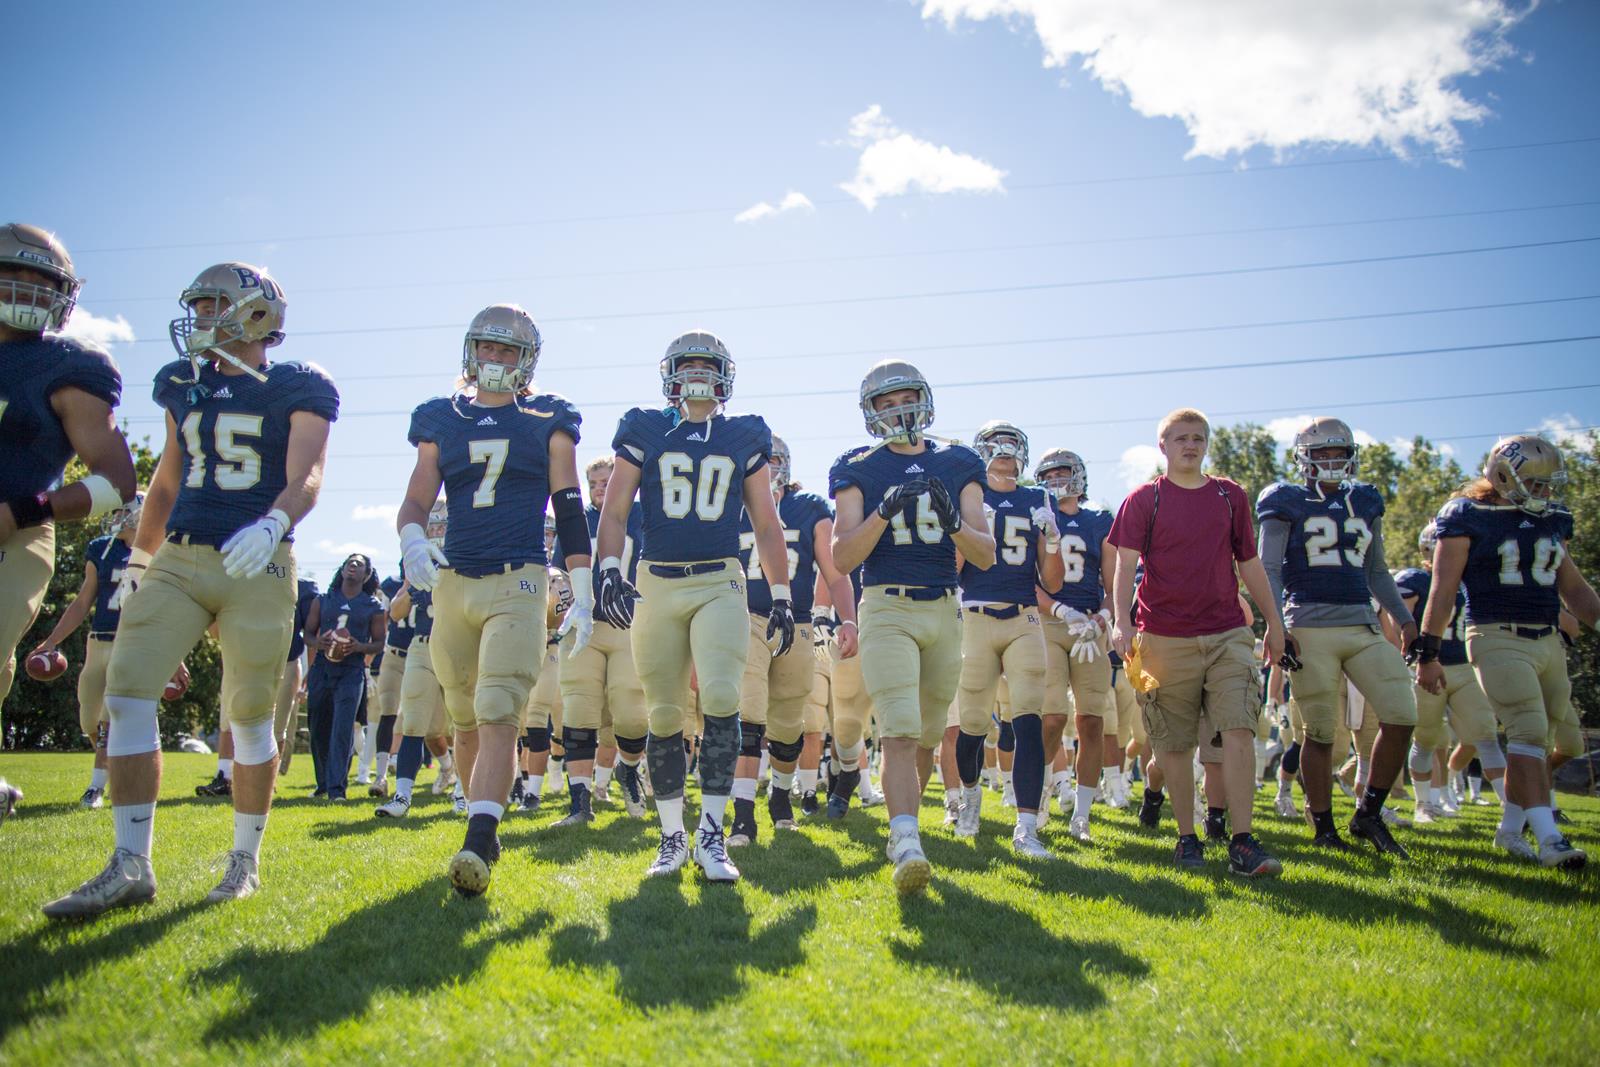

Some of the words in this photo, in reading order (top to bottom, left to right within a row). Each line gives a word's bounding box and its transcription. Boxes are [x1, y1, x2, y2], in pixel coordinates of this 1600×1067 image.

[231, 267, 276, 301] BU
[181, 411, 264, 490] 15
[468, 438, 510, 509] 7
[658, 451, 736, 522] 60
[1303, 516, 1373, 568] 23
[1498, 539, 1565, 585] 10
[266, 562, 286, 579] BU
[519, 580, 537, 594] BU
